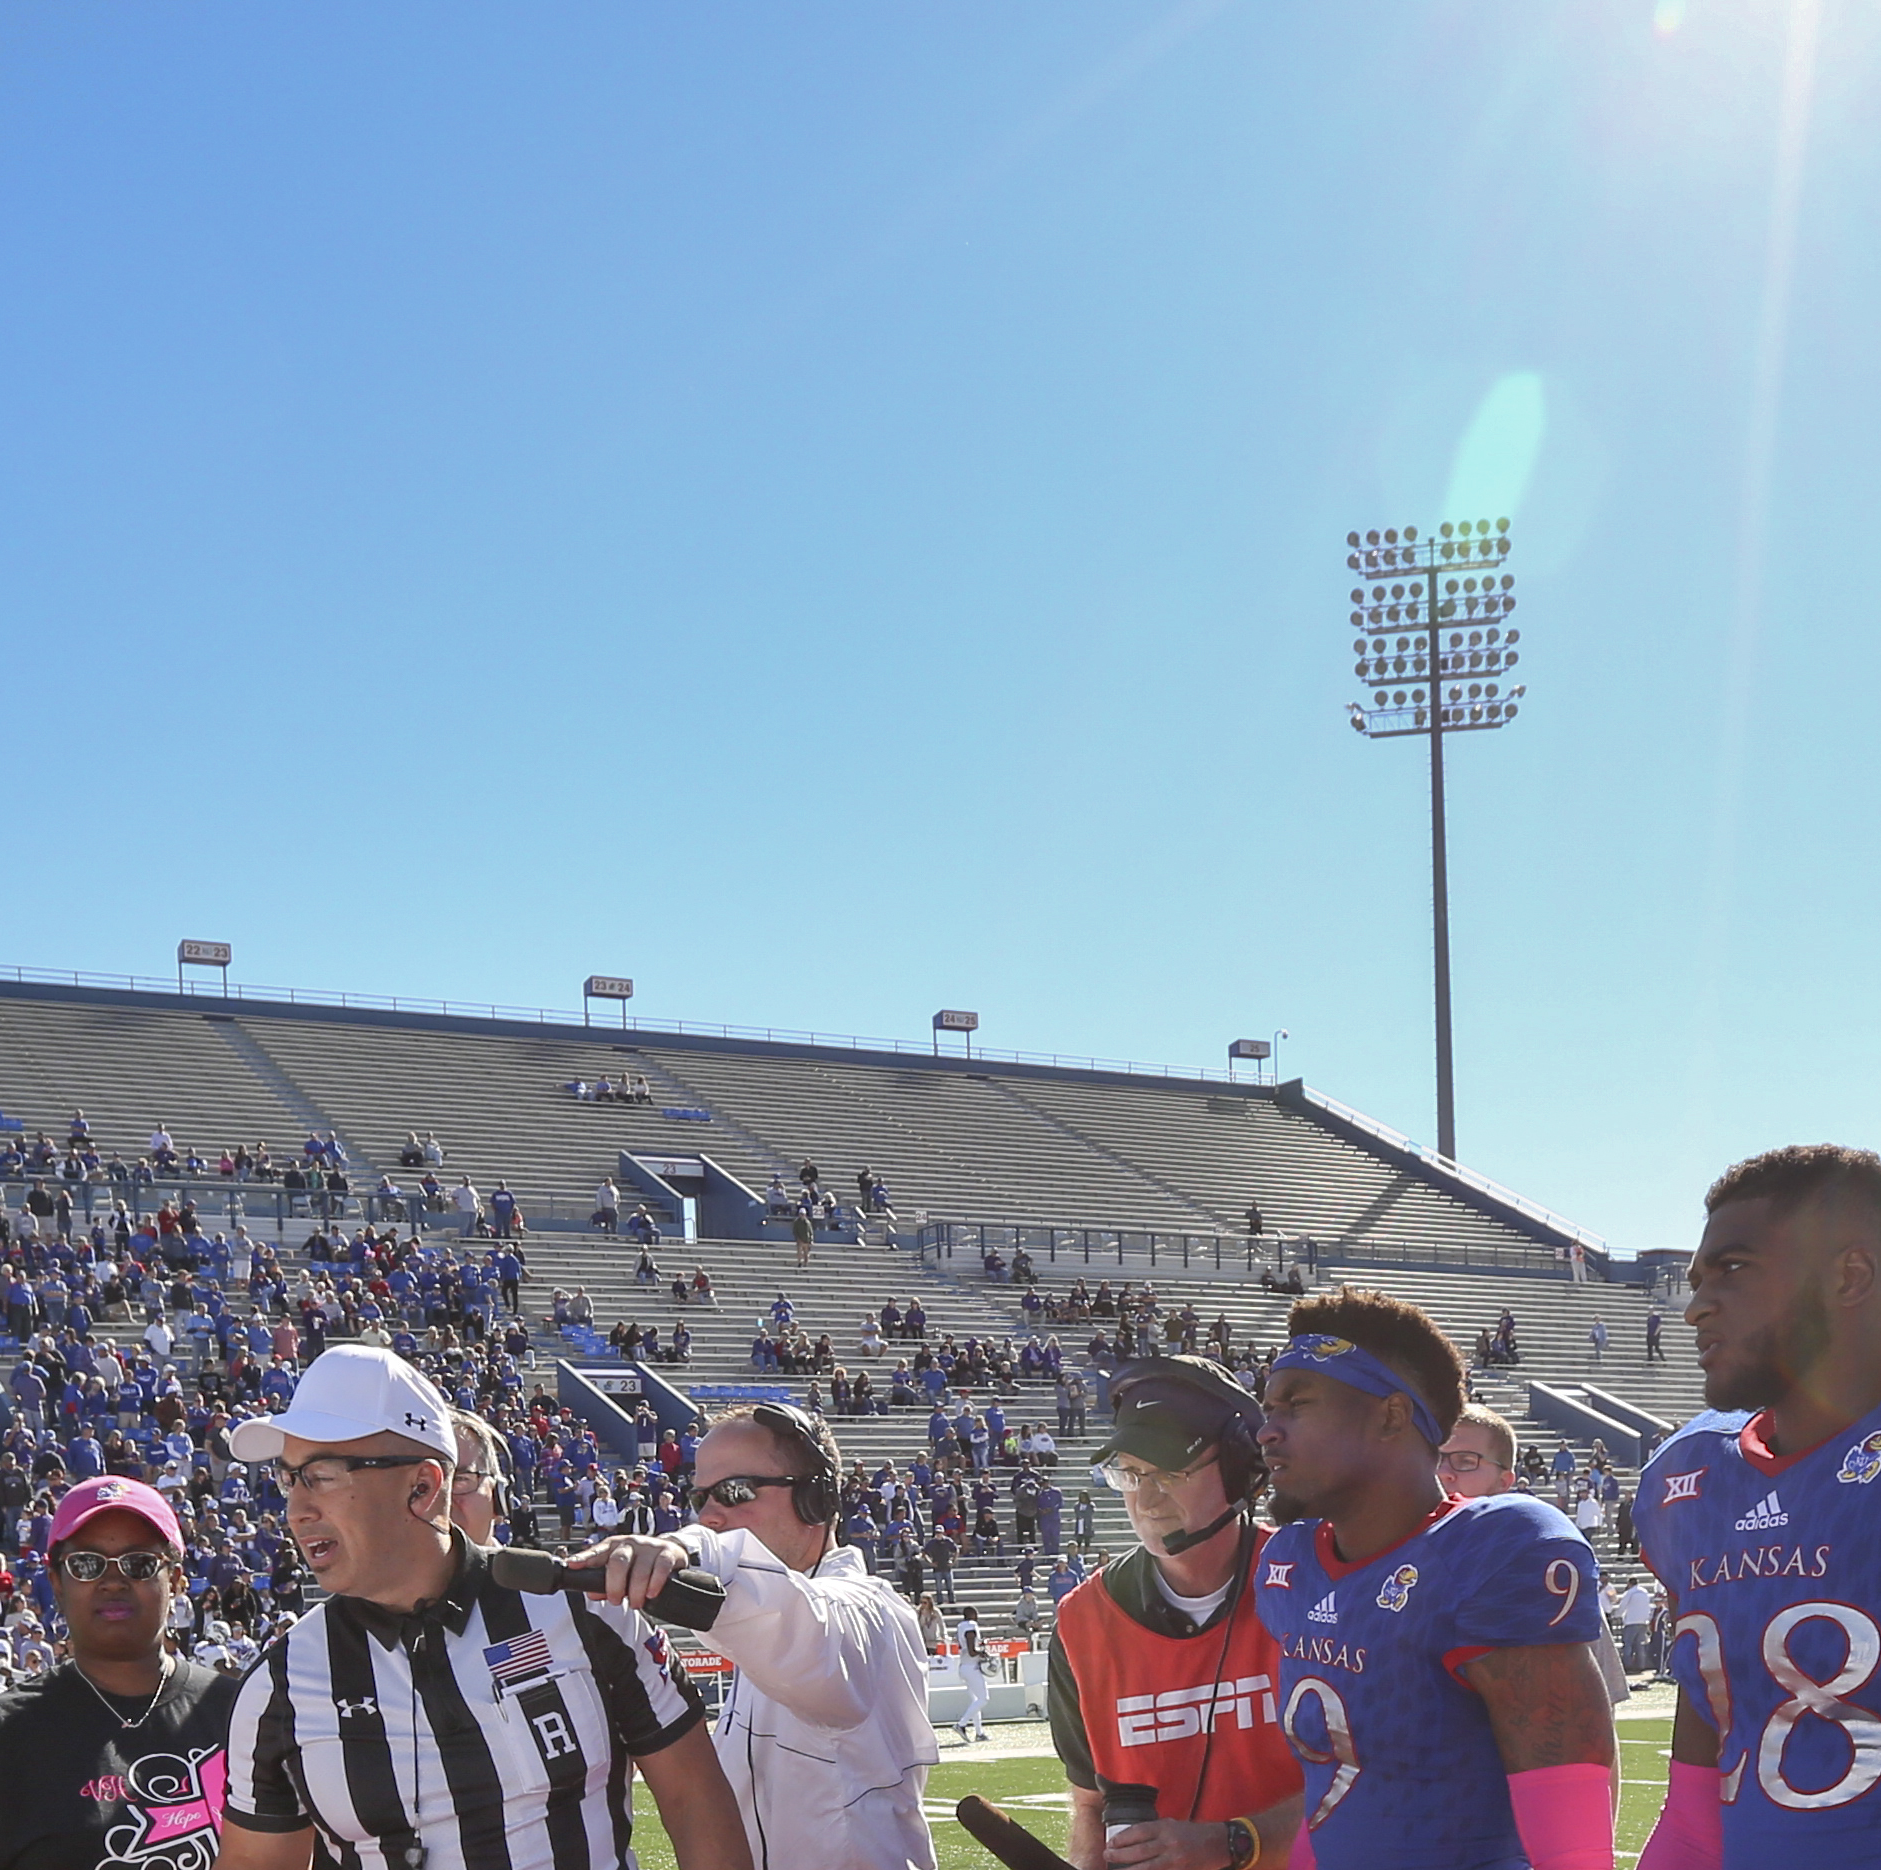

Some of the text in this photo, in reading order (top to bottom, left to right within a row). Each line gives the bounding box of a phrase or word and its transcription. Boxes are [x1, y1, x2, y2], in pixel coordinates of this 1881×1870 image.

[186, 945, 201, 956] 22
[213, 948, 228, 958] 23
[594, 980, 630, 993] 23 24
[944, 1014, 975, 1025] 24 25
[663, 1163, 676, 1174] 23
[620, 1380, 636, 1392] 23
[1662, 1469, 1705, 1505] XII
[1735, 1512, 1790, 1532] adidas
[1266, 1562, 1295, 1588] XII
[1689, 1544, 1831, 1591] KANSAS
[1544, 1558, 1580, 1627] 9
[1307, 1609, 1339, 1625] adidas
[680, 1656, 723, 1668] TORADE
[1282, 1632, 1366, 1676] KANSAS
[1115, 1672, 1278, 1749] ESPN
[532, 1711, 577, 1761] R
[1281, 1675, 1362, 1832] 9
[161, 1809, 202, 1829] Hope
